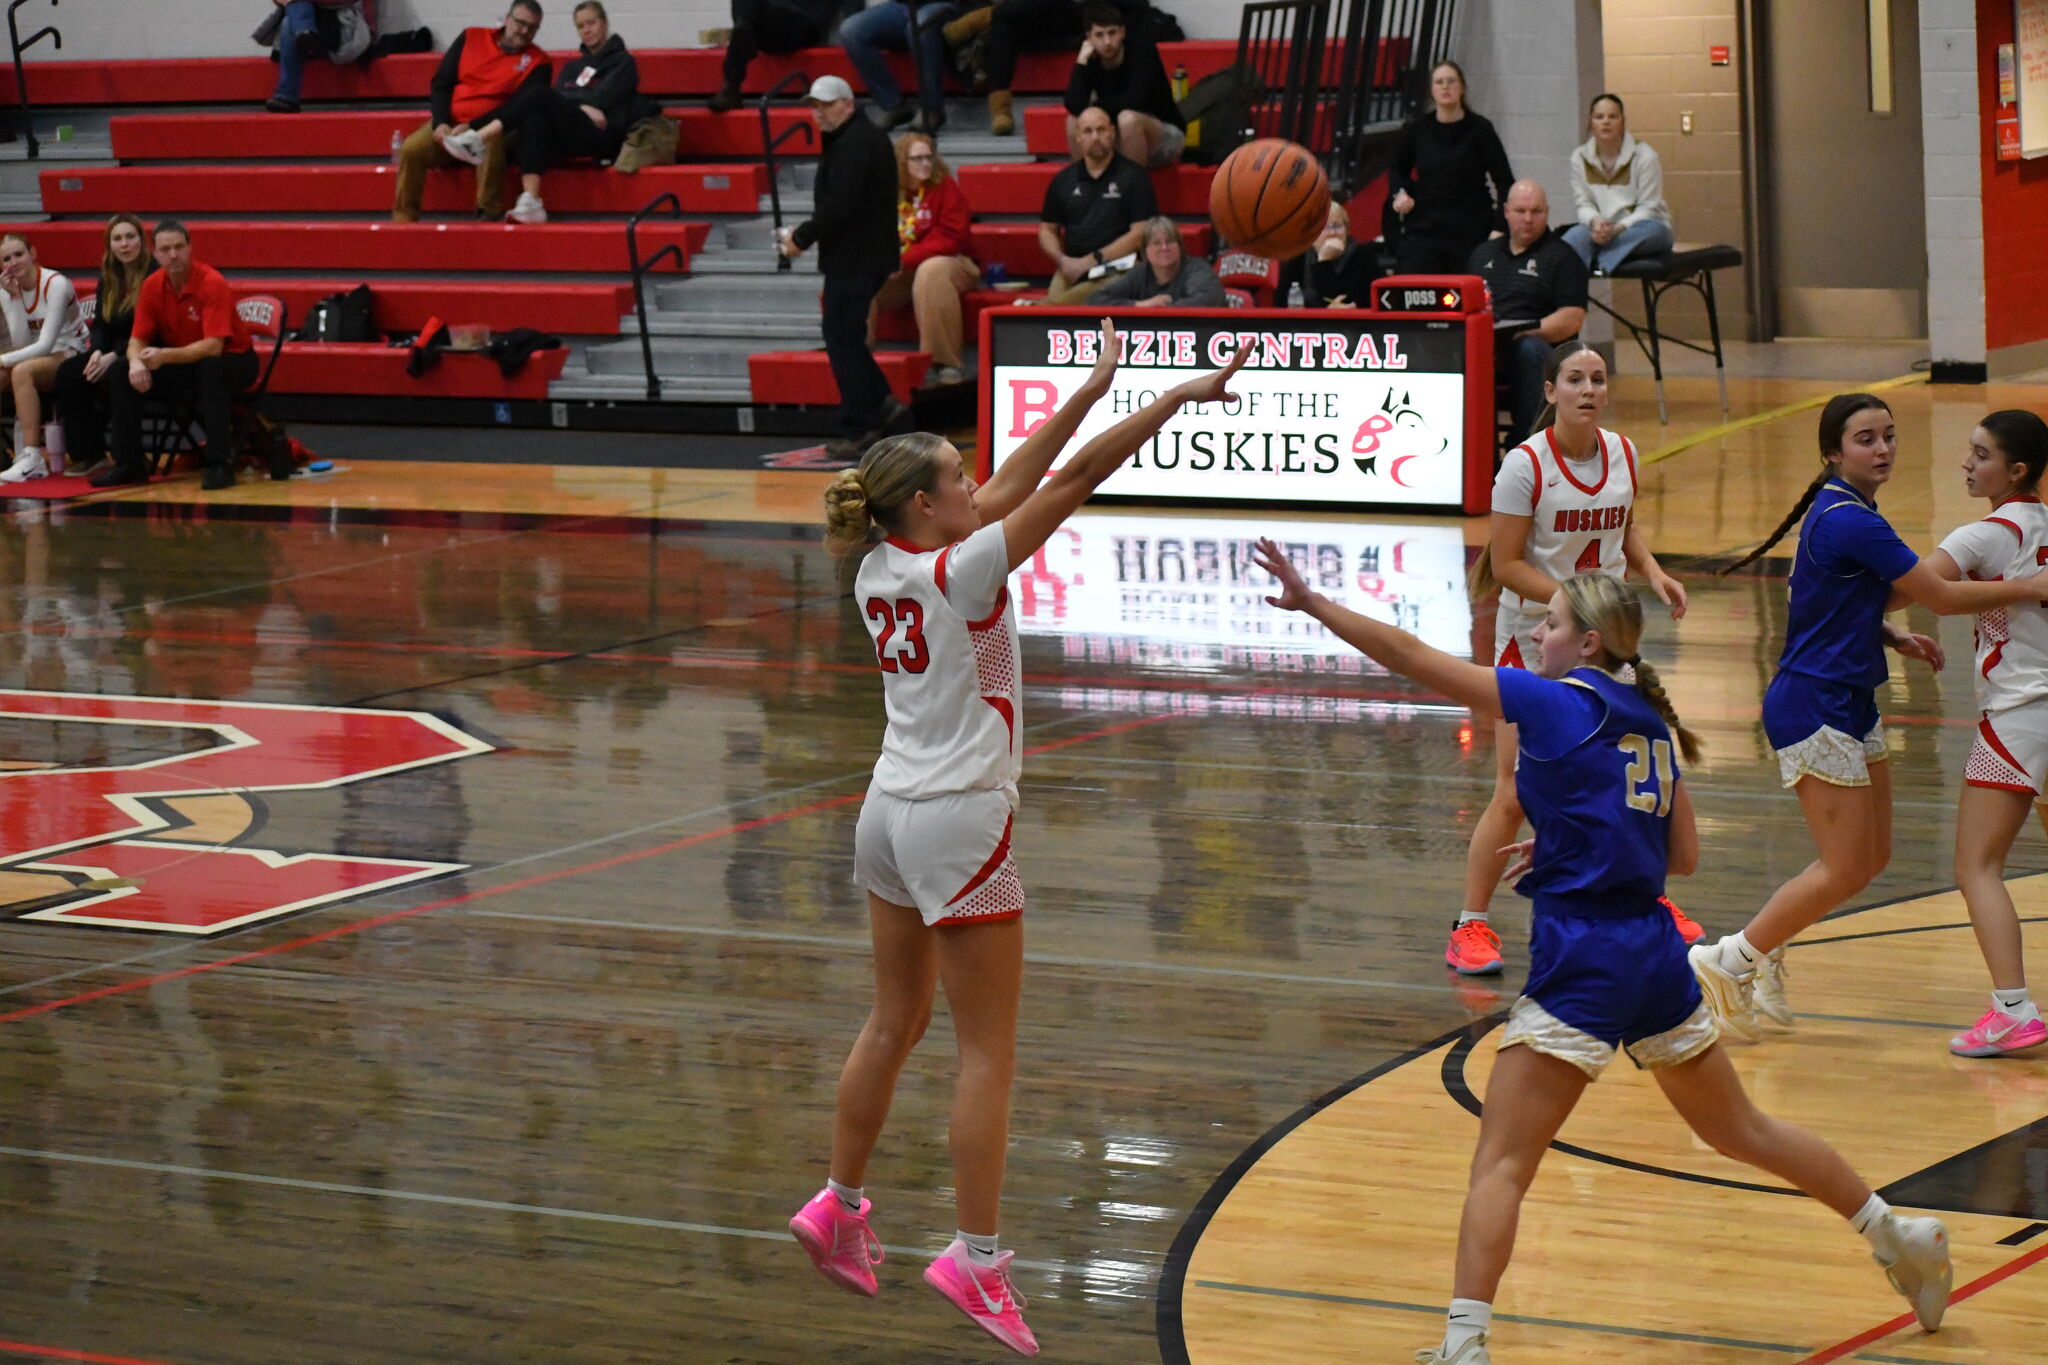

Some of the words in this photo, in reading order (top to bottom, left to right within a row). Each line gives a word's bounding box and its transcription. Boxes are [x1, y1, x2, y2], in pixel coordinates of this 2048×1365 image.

[236, 301, 274, 325] USKIES
[1404, 290, 1437, 309] poss
[1207, 331, 1408, 369] CENTRAL
[1113, 390, 1209, 415] HO
[1222, 392, 1263, 416] OF
[1273, 392, 1339, 418] THE
[1554, 505, 1626, 532] HUSKIES
[1575, 538, 1602, 573] 4
[866, 597, 930, 674] 23
[1617, 733, 1674, 817] 21
